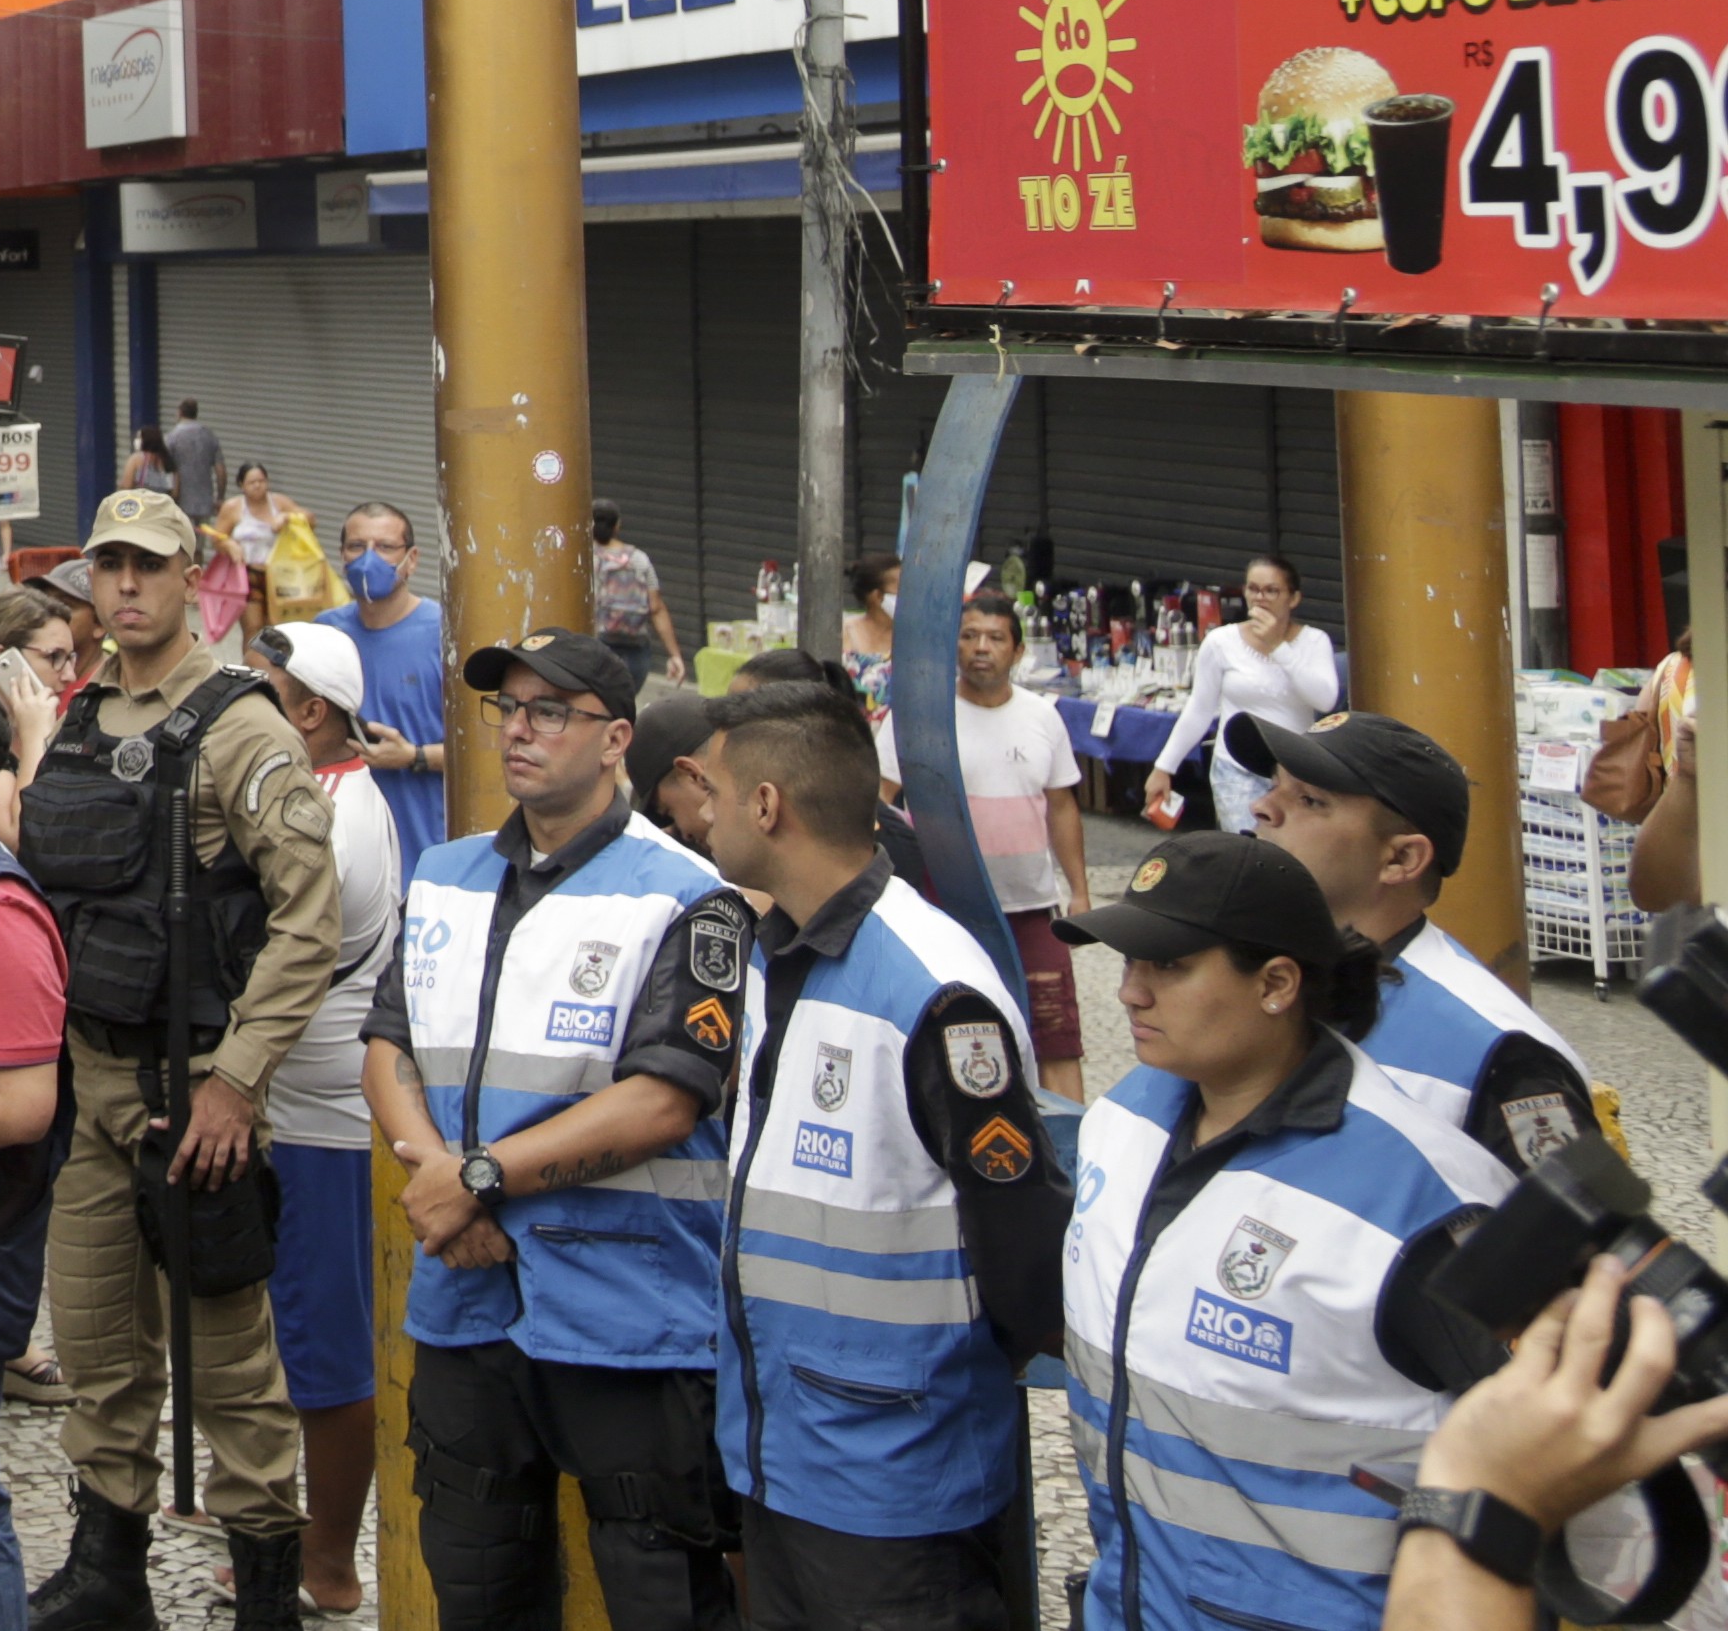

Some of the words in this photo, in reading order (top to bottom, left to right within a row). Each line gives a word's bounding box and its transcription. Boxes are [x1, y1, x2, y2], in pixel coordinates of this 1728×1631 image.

[1054, 6, 1091, 52] do
[1464, 40, 1494, 69] R$
[1460, 35, 1728, 296] 4,9
[1018, 173, 1082, 232] TIO
[1087, 155, 1137, 231] ZÉ
[705, 897, 740, 925] OQUE
[553, 1007, 594, 1030] RIO
[946, 1023, 999, 1037] PMERJ
[551, 1027, 611, 1043] PREFEITURA
[1505, 1094, 1563, 1116] PMERJ
[798, 1127, 831, 1156] RIO
[795, 1151, 848, 1173] PREFEITURA
[1242, 1218, 1294, 1249] PMERJ
[1192, 1298, 1253, 1341] RIO
[1189, 1324, 1283, 1366] PREFEITURA
